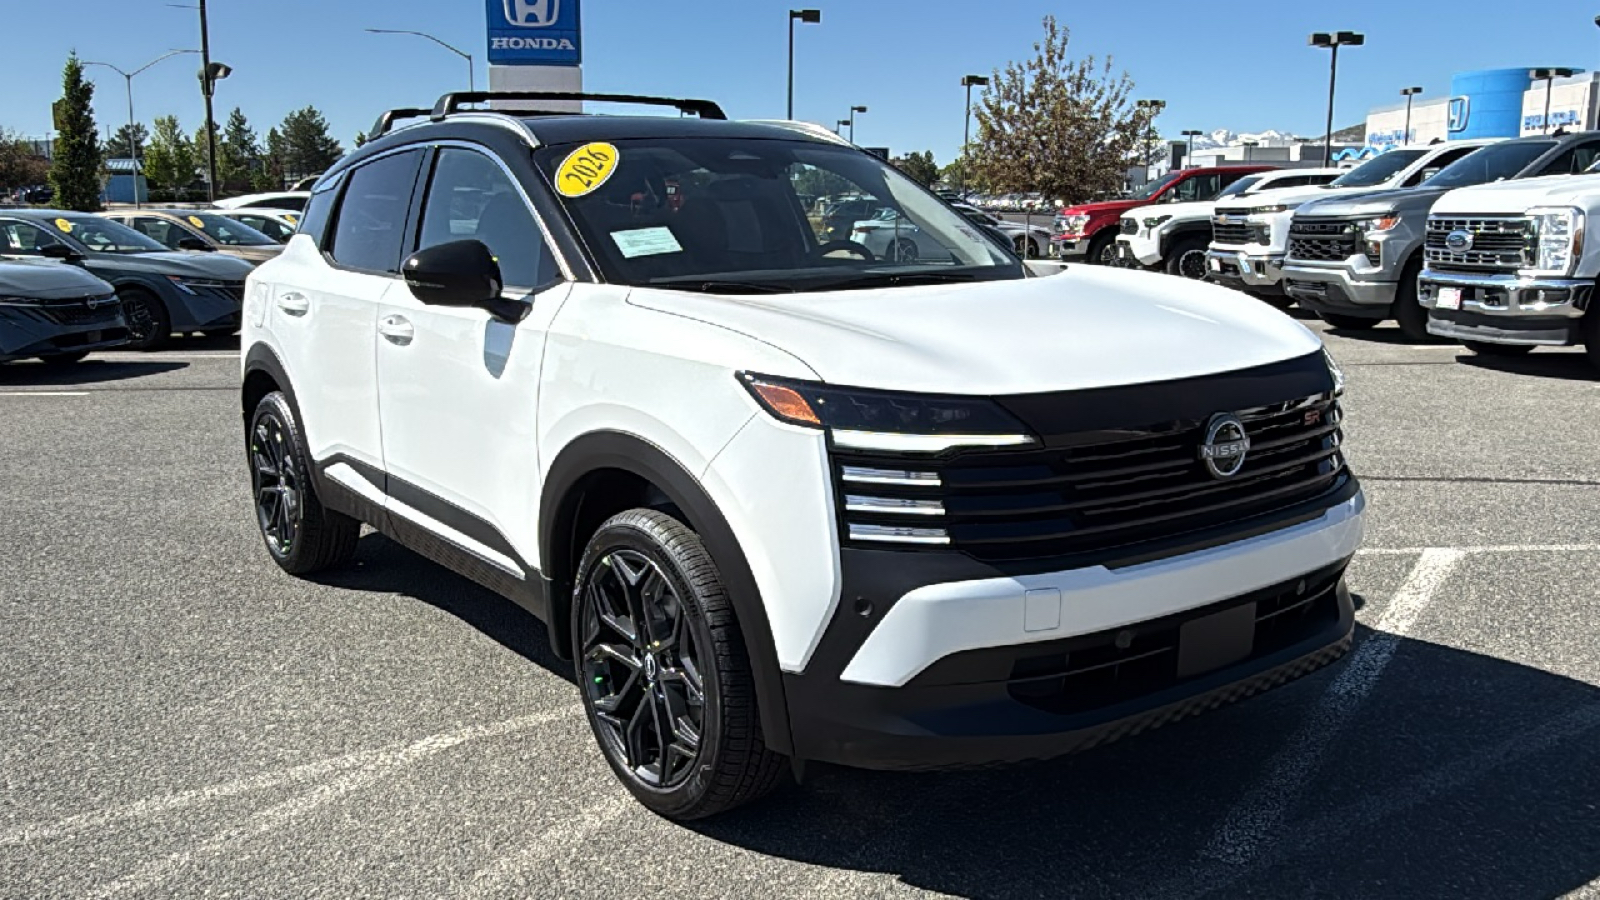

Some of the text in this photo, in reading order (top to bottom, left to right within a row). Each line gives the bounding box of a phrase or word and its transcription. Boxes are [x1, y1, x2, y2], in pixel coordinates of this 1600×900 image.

[491, 37, 575, 50] HONDA
[565, 148, 610, 187] 2026
[1304, 410, 1321, 426] SR
